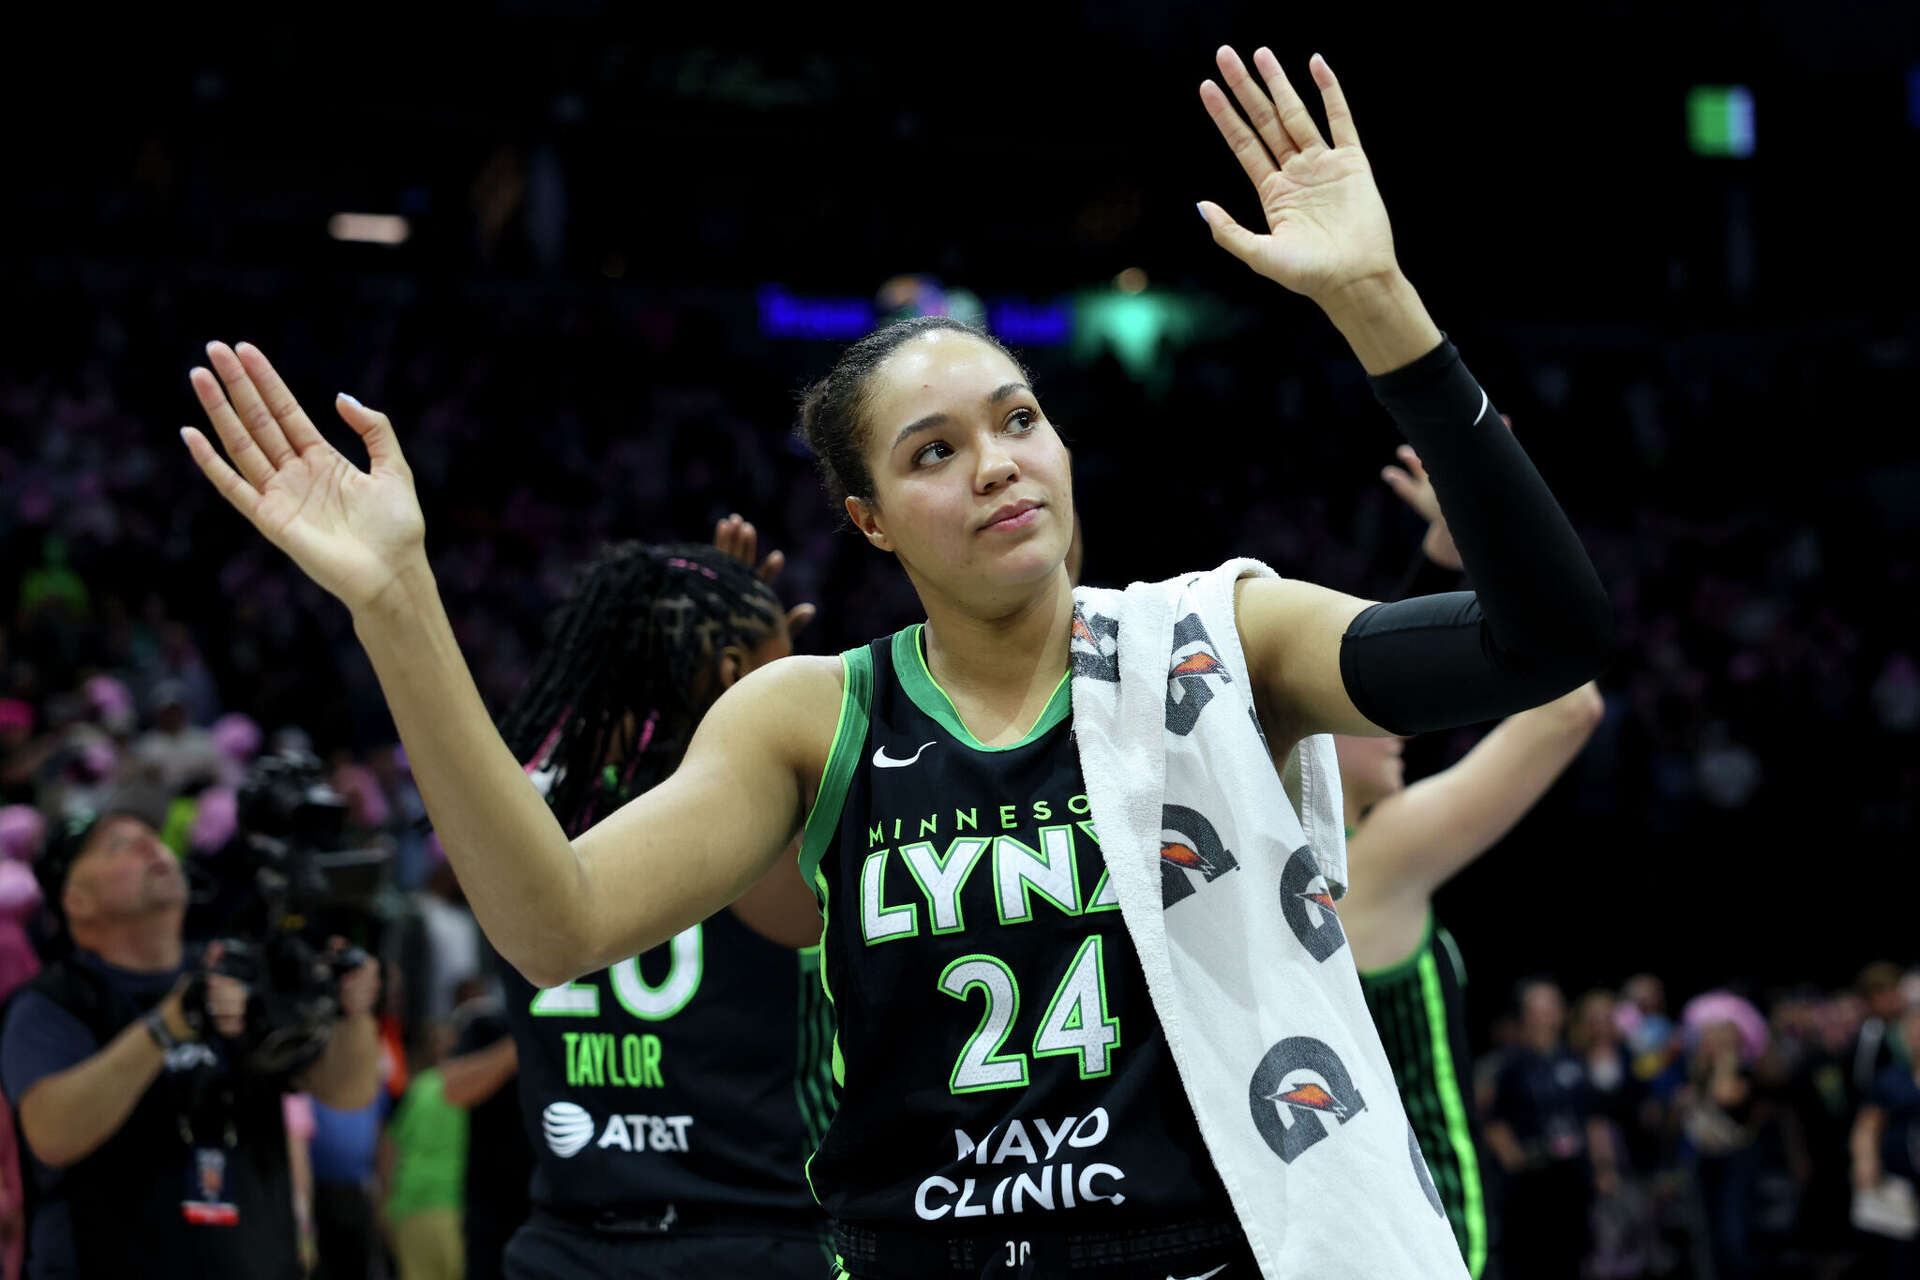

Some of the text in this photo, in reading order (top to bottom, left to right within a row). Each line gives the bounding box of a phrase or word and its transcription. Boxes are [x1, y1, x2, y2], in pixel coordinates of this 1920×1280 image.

[869, 795, 1090, 848] MINNESO
[937, 934, 1121, 1095] 24
[562, 1032, 664, 1087] TAYLOR
[1249, 1036, 1368, 1165] G
[597, 1114, 694, 1151] AT&T
[954, 1106, 1110, 1165] MAYO
[914, 1162, 1126, 1221] CLINIC
